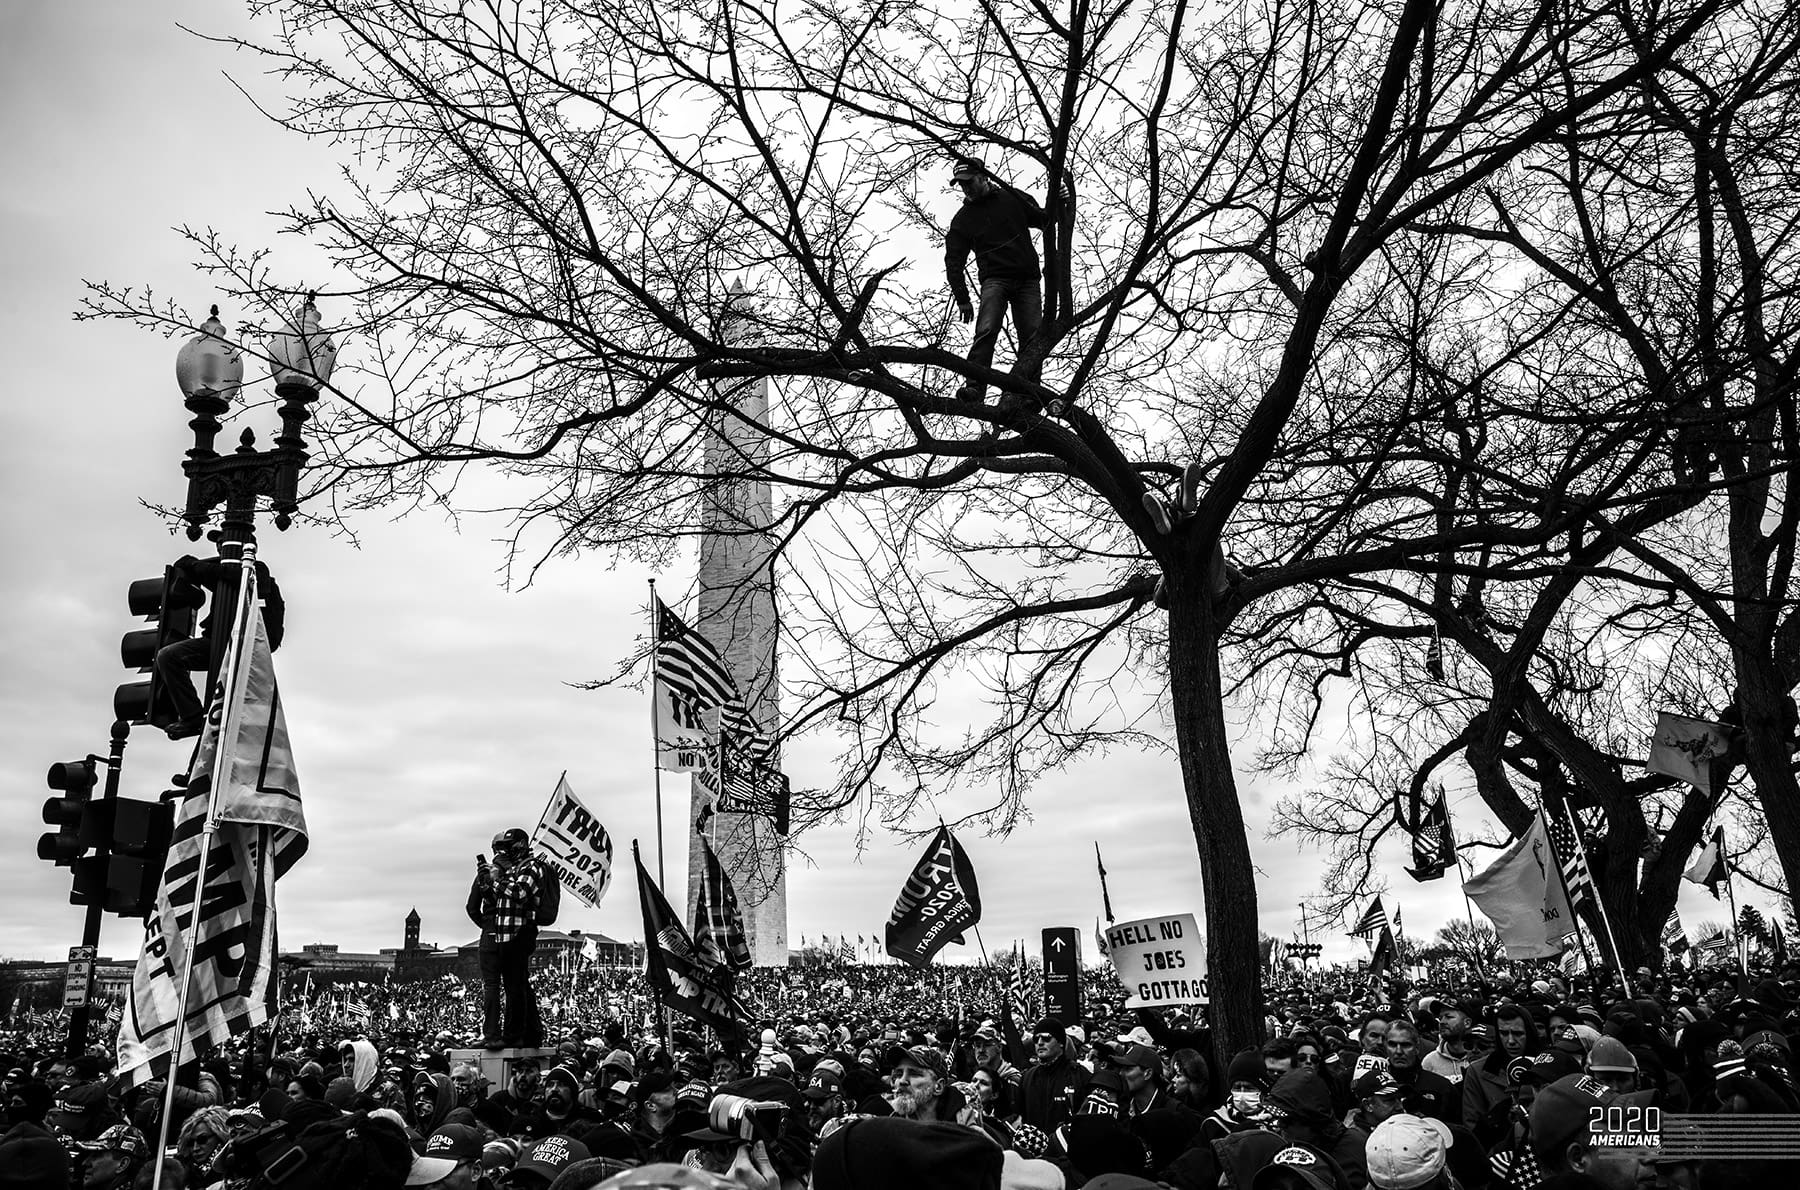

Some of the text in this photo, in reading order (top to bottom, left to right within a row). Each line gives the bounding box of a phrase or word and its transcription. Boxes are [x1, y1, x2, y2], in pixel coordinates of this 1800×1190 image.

[678, 752, 694, 767] NO
[1109, 920, 1183, 949] HELL NO
[75, 964, 82, 972] NO
[545, 1136, 568, 1147] KEEP
[531, 1144, 570, 1161] AMERICA
[532, 1152, 562, 1166] GREAT
